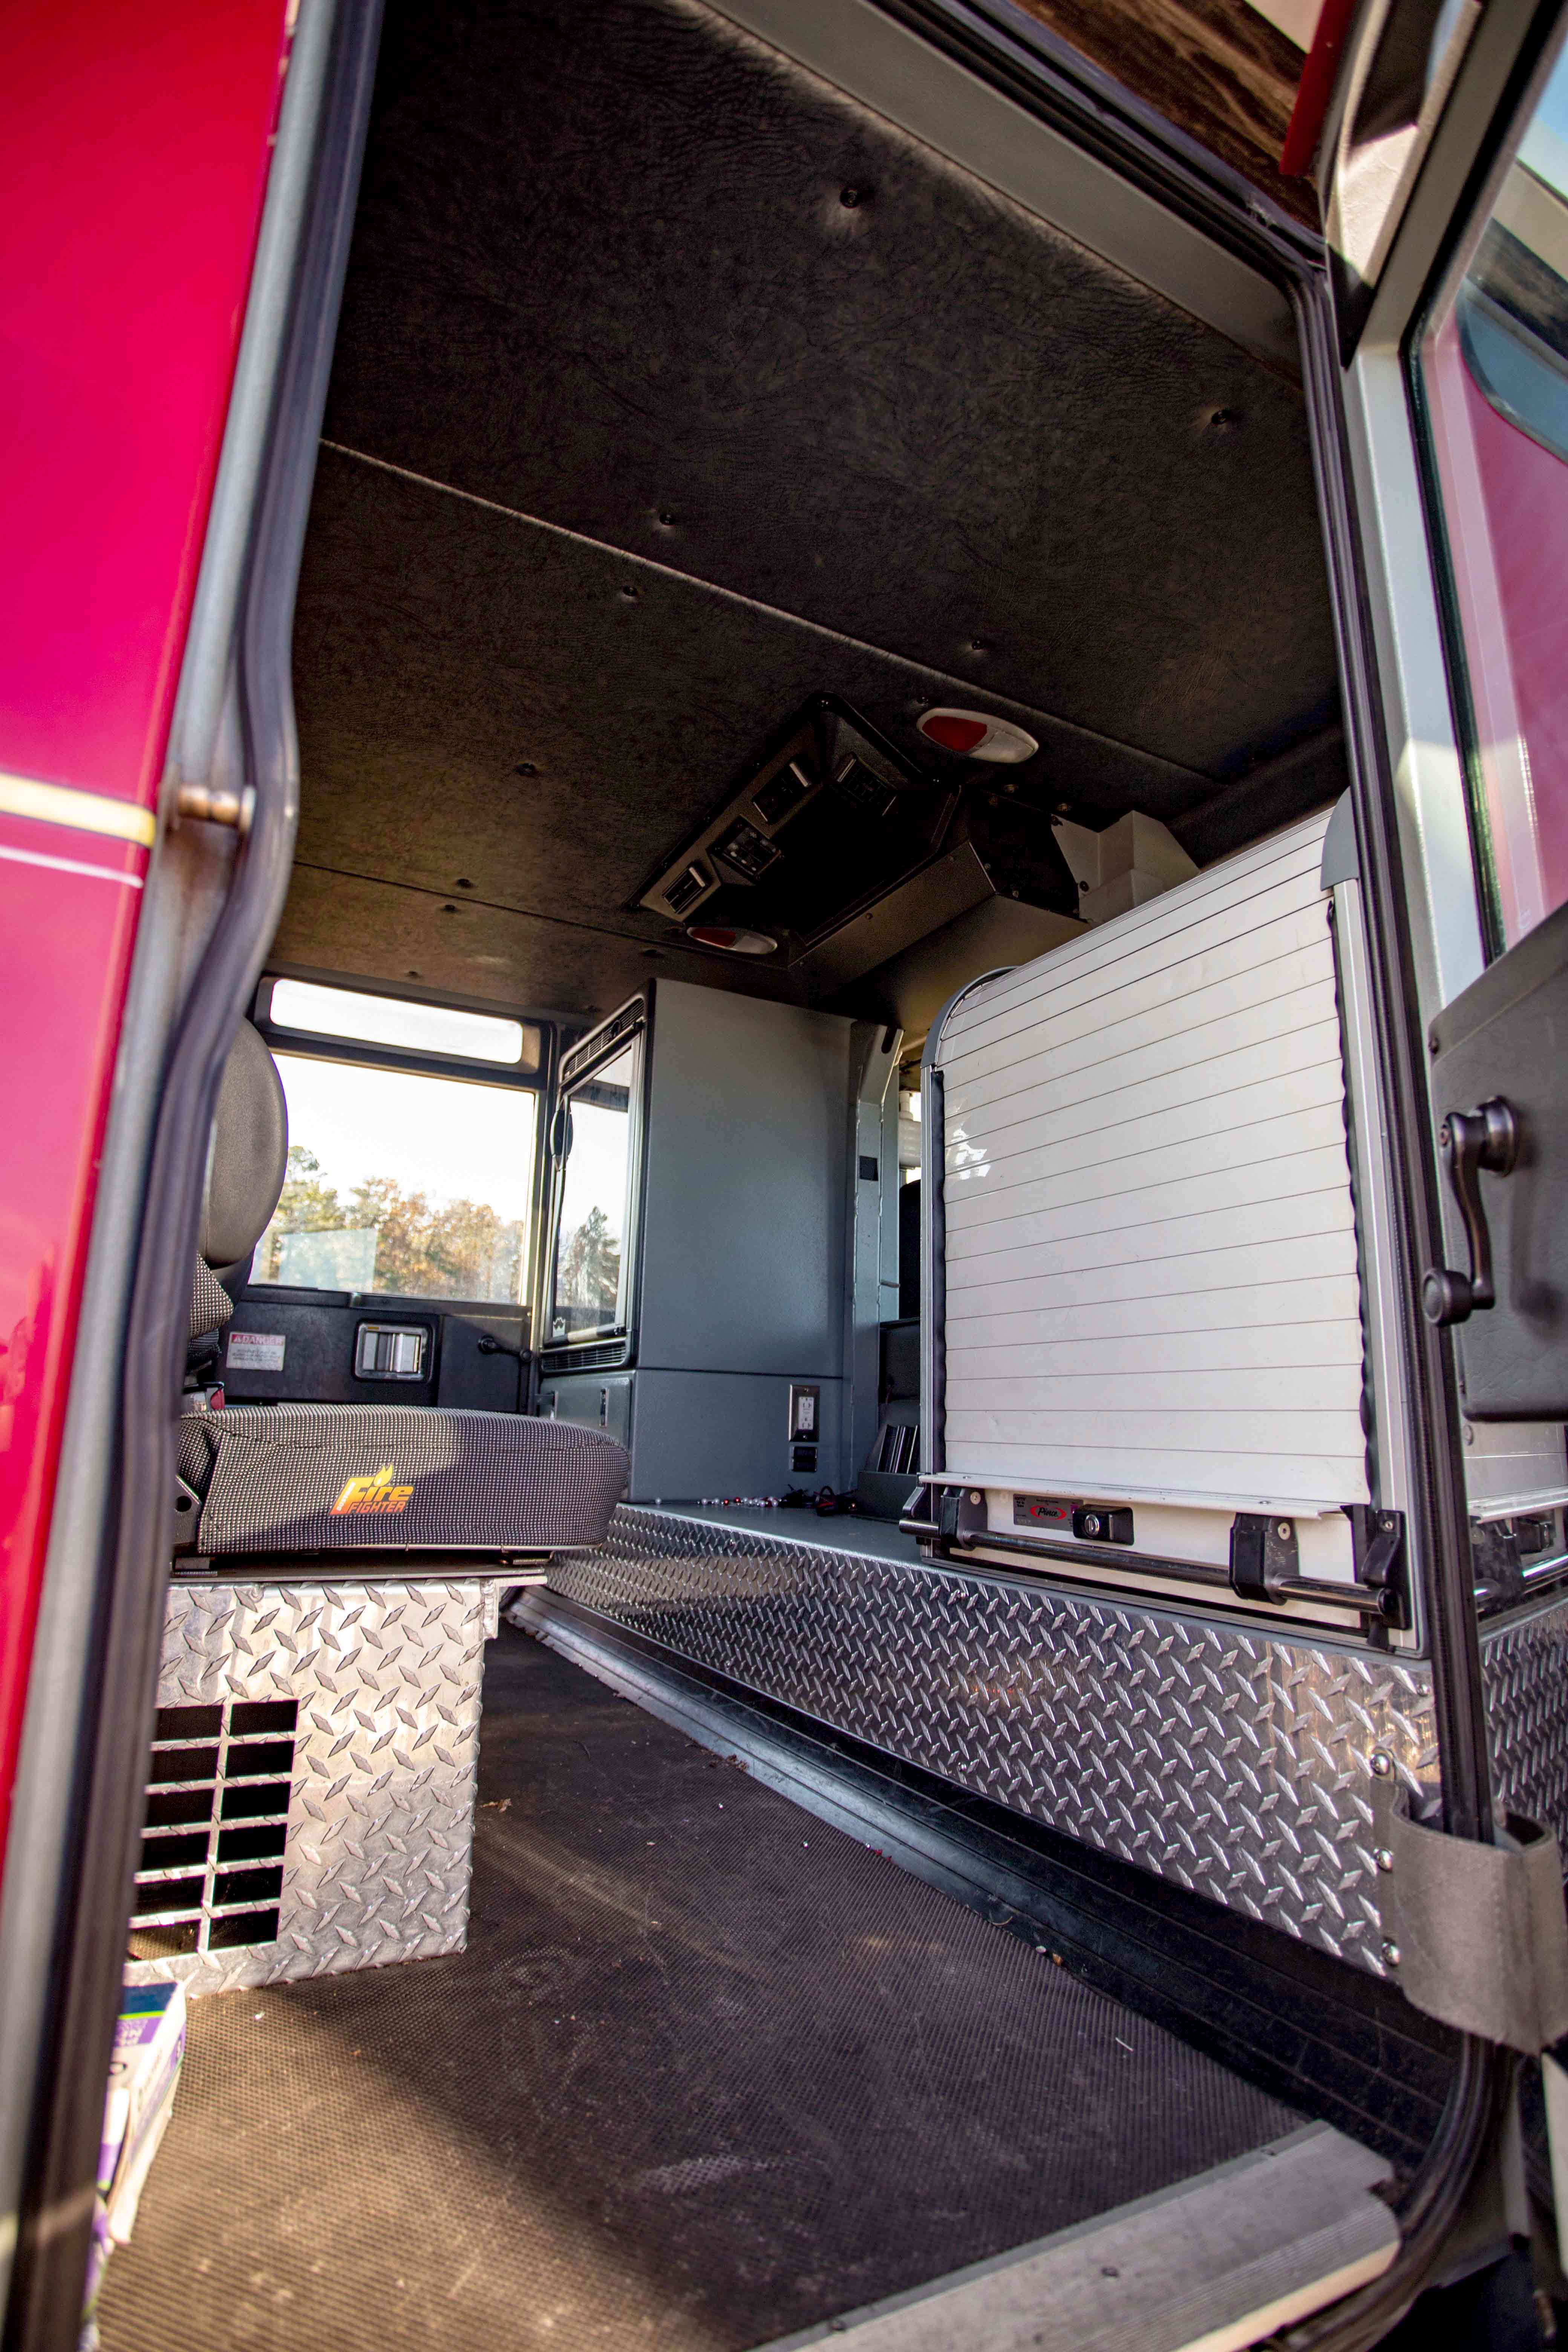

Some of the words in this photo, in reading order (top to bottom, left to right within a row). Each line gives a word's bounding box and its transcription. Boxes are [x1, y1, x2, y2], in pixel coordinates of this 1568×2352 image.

[243, 1335, 283, 1345] DANGER
[328, 1475, 414, 1514] Fire
[348, 1501, 406, 1513] FIGHTER
